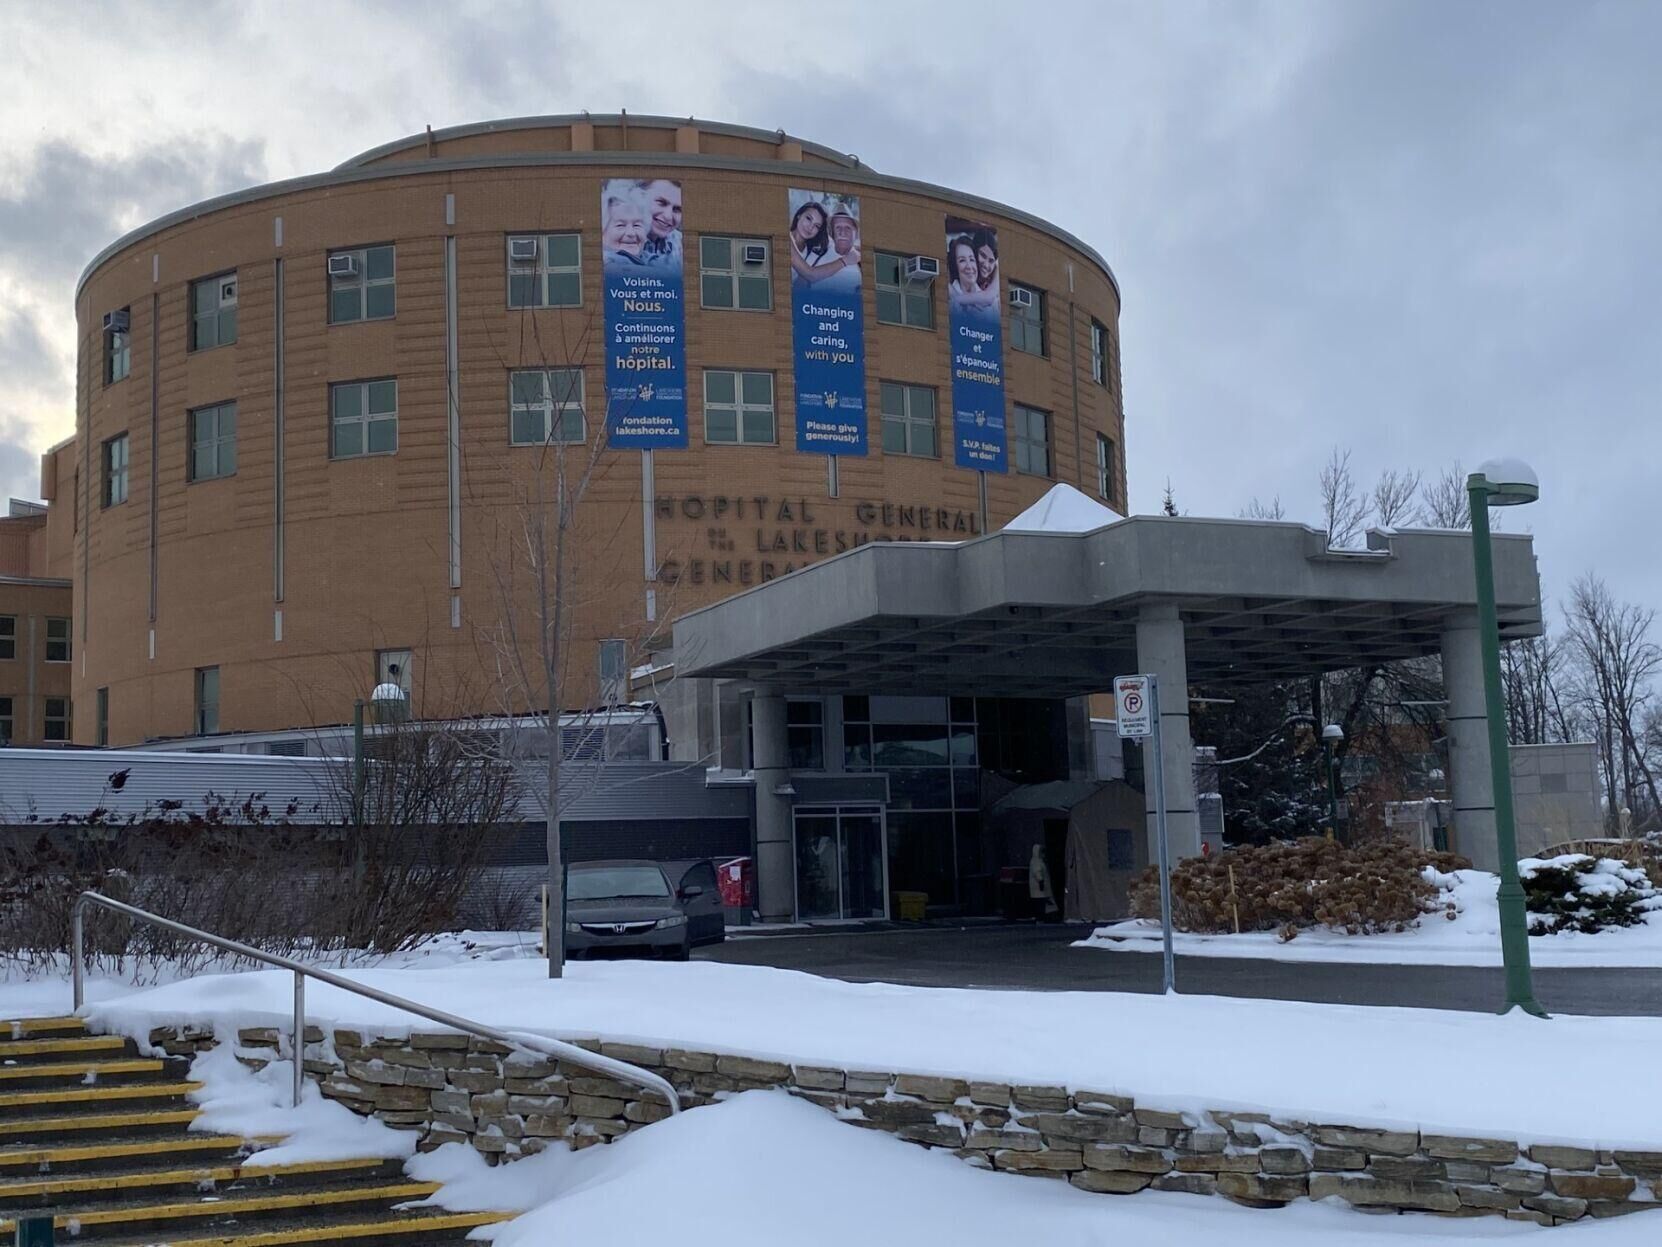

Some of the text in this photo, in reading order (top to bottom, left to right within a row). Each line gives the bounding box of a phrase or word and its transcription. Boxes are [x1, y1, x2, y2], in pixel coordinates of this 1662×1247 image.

[623, 277, 664, 287] Voisins.
[610, 288, 678, 300] Vous et moi.
[624, 300, 665, 312] Nous.
[802, 304, 855, 320] Changing
[615, 323, 675, 333] Continuons
[819, 321, 839, 332] and
[615, 334, 675, 343] à améliorer
[959, 326, 993, 342] Changer
[811, 336, 848, 350] caring,
[973, 344, 982, 353] et
[631, 346, 660, 354] notre
[805, 350, 854, 364] with you
[616, 356, 676, 371] hôpital.
[956, 354, 1000, 373] s'épanouir,
[957, 369, 1001, 386] ensemble
[623, 416, 673, 425] fondation
[615, 426, 680, 436] lakeshore.ca
[806, 421, 857, 433] Please give
[806, 431, 859, 443] generously!
[962, 440, 1000, 453] S.V.P. faites
[969, 451, 978, 459] un
[857, 503, 982, 535] GENERAL
